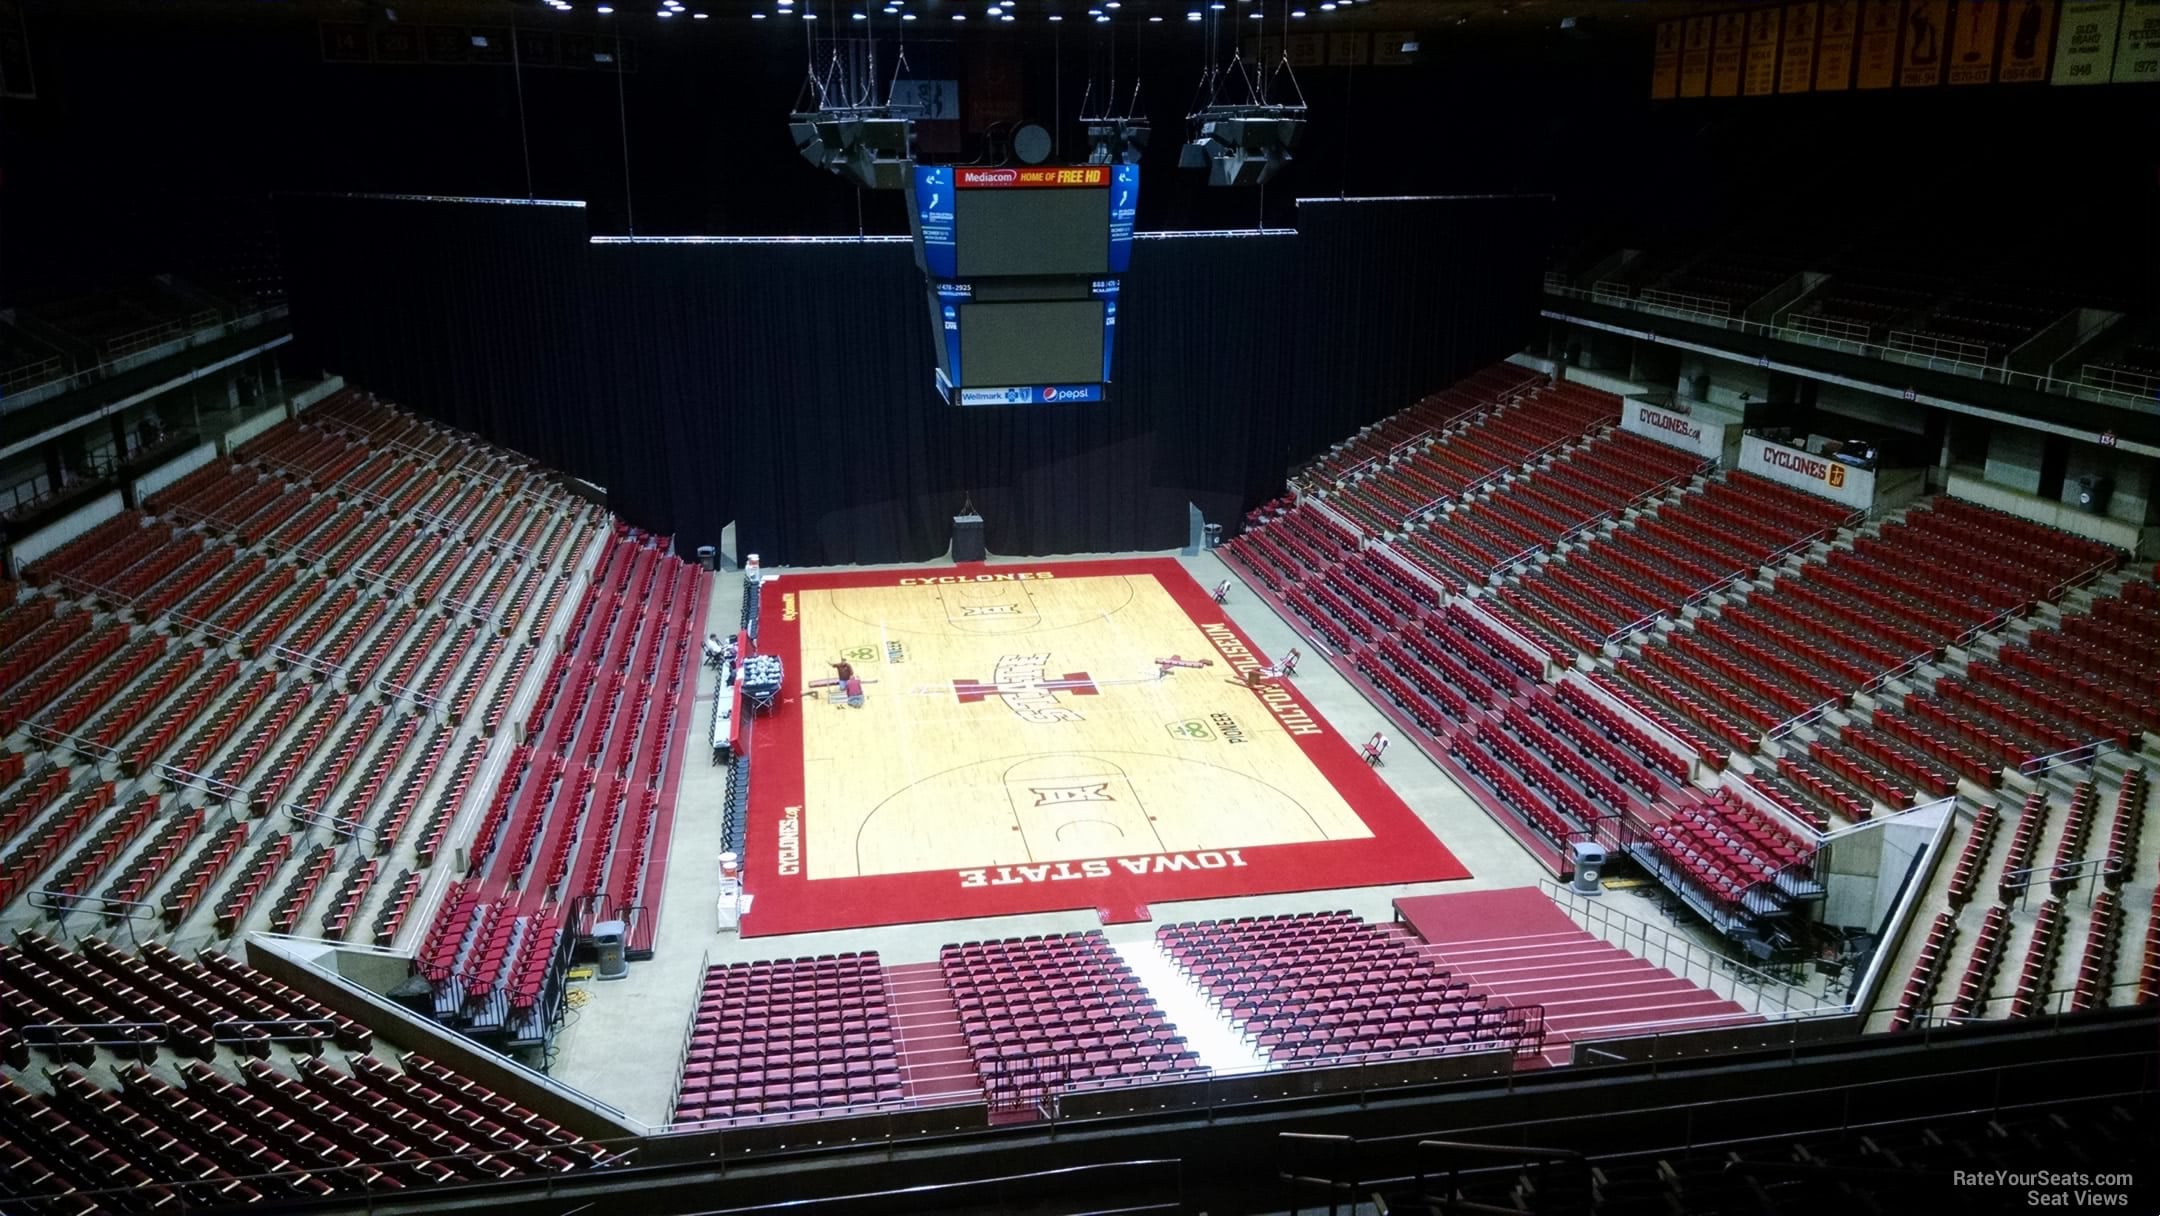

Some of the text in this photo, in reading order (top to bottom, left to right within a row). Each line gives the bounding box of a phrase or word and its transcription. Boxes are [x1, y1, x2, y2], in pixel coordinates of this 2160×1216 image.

[2134, 60, 2158, 73] 1972
[965, 170, 1101, 183] Mediacom HOME OF FREE HD
[963, 388, 1089, 401] Wellmark pepsi
[1764, 447, 1827, 480] CYCLONES
[899, 571, 1054, 586] CYCLONES
[1254, 683, 1323, 735] HILTON
[1210, 712, 1249, 744] PIONEER
[959, 849, 1249, 888] IOWA STATE
